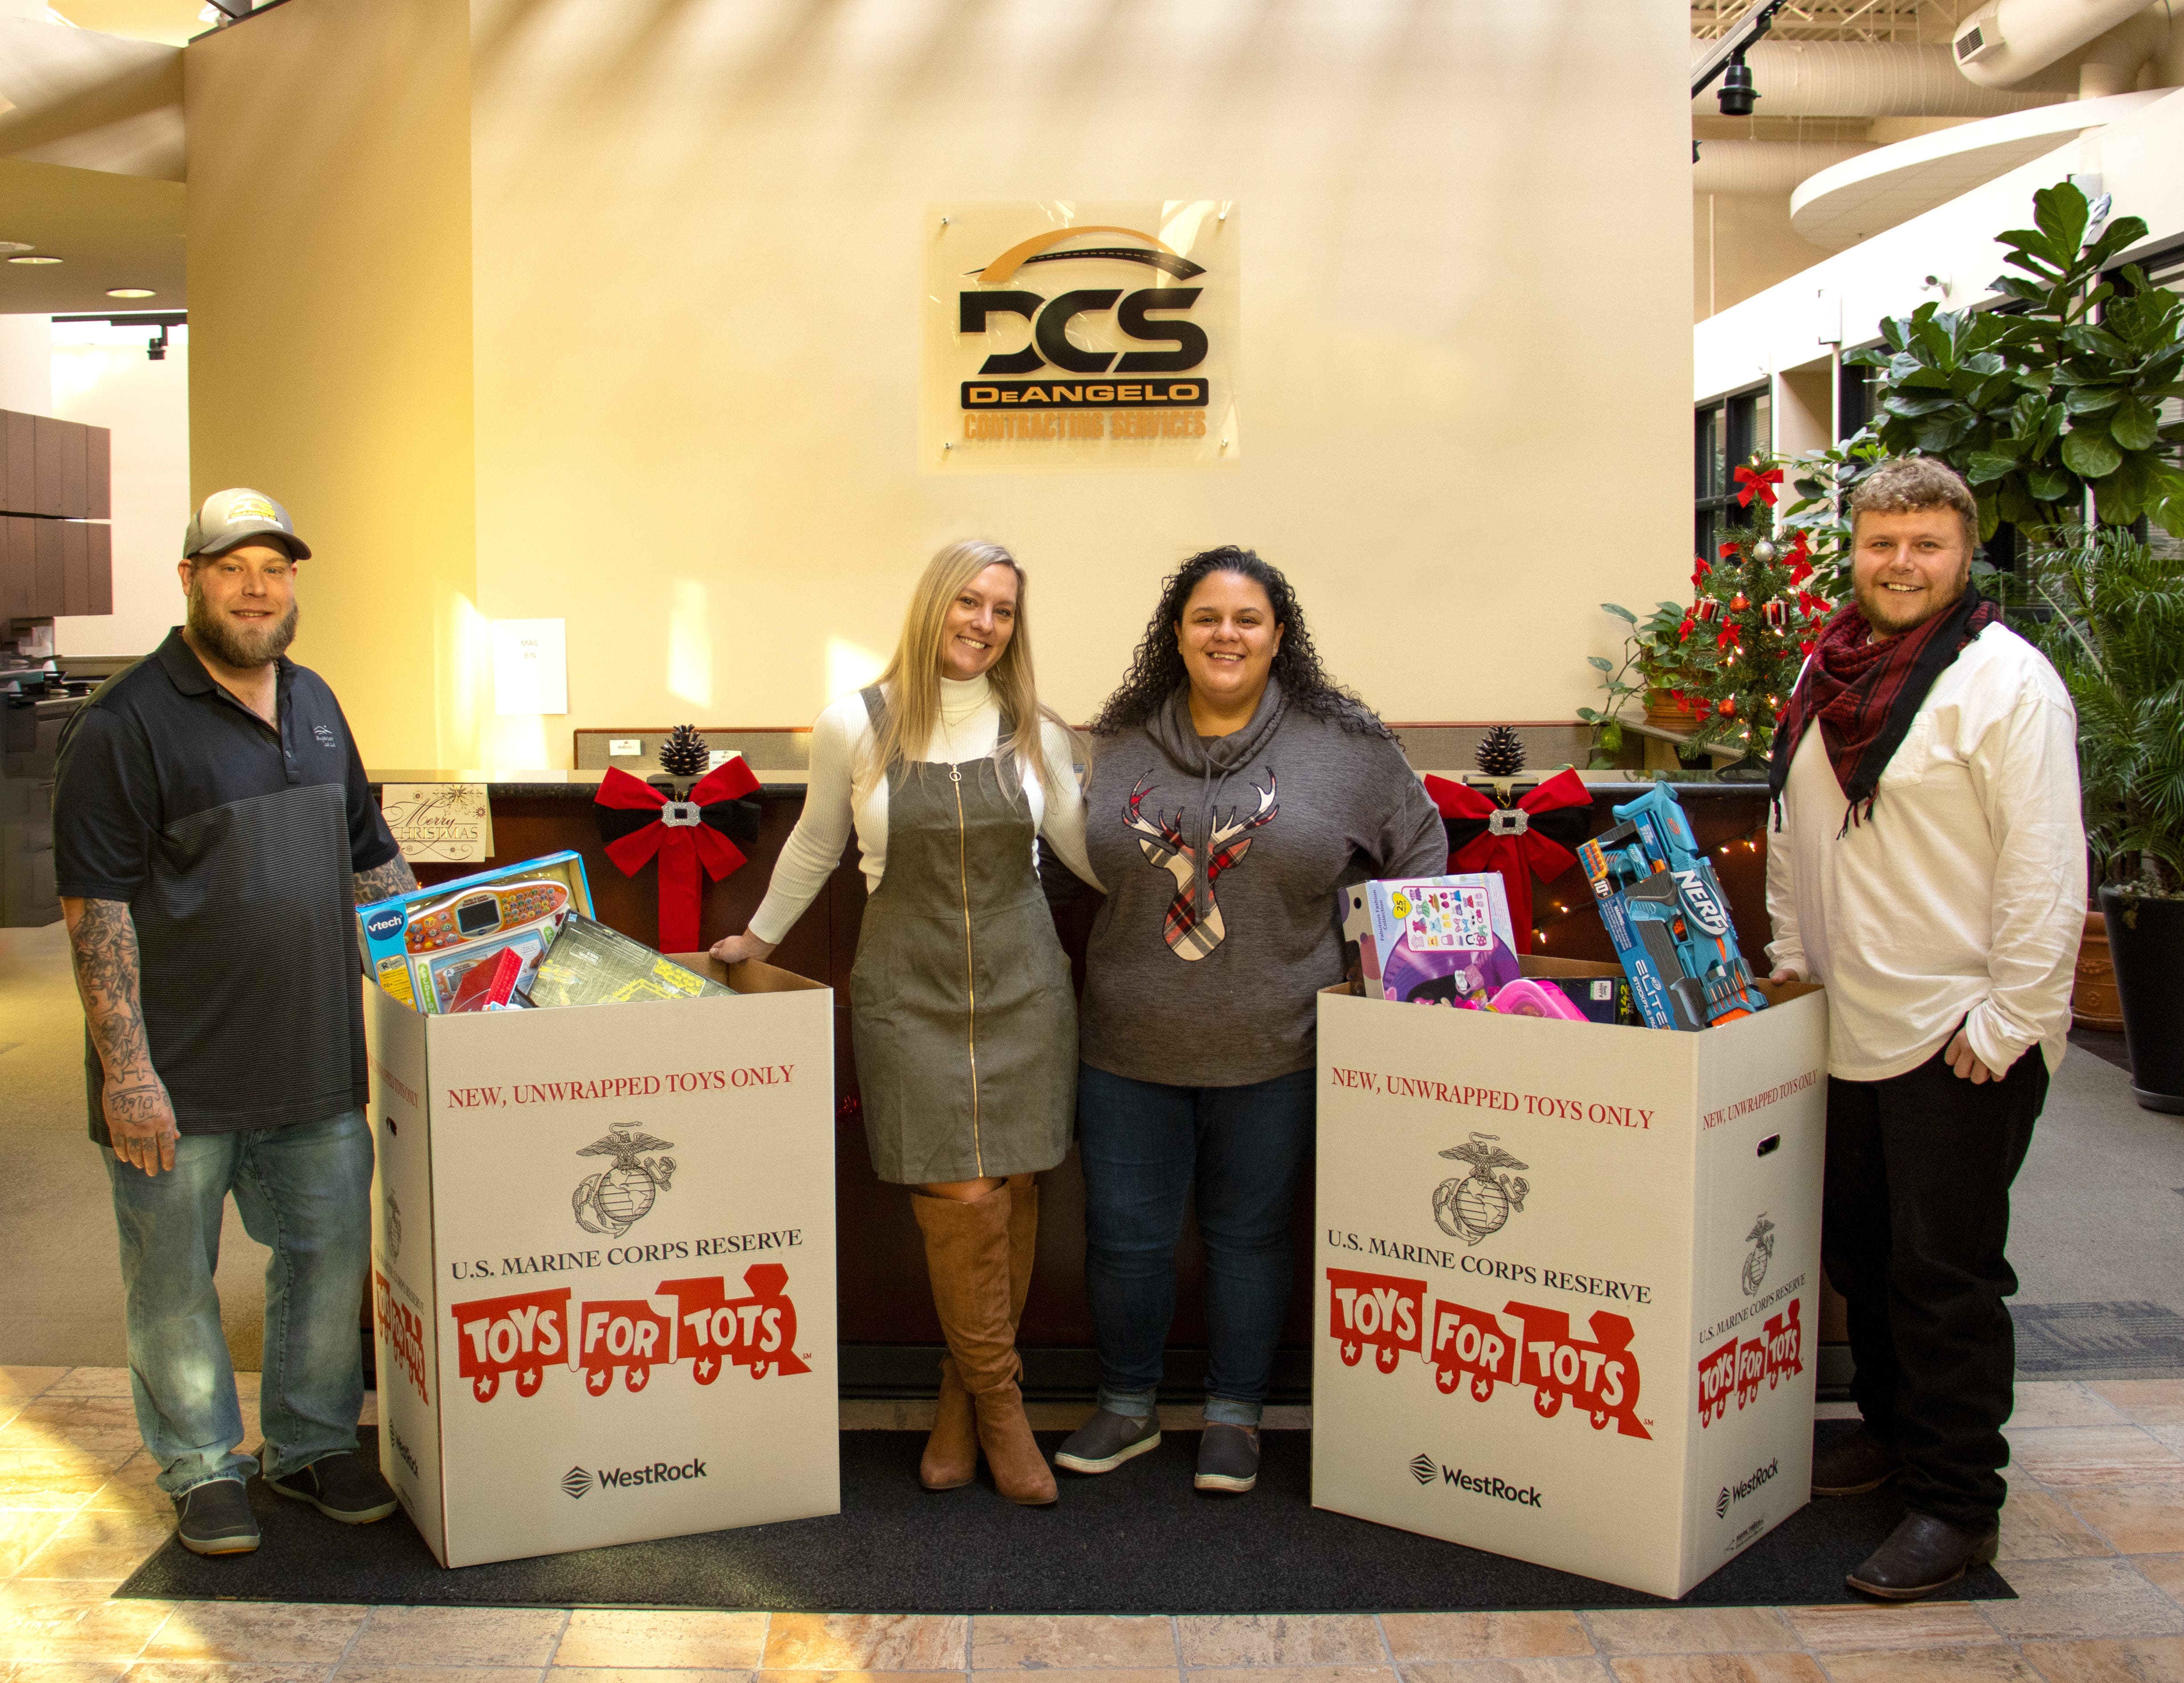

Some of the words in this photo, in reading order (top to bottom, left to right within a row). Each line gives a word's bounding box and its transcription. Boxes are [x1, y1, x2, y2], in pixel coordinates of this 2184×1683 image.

[960, 287, 1208, 374] DCS
[964, 411, 1105, 440] CONTRACTING
[1112, 410, 1207, 438] SERVICES
[391, 827, 478, 839] CHRISTMAS
[396, 796, 456, 829] Merry
[1380, 900, 1388, 930] Collection
[1397, 900, 1403, 911] 25
[1671, 869, 1729, 931] NERF
[368, 916, 403, 932] vtech
[382, 962, 389, 970] R
[1632, 976, 1652, 1016] STOCKPILE
[1635, 959, 1668, 1026] ELITE
[447, 1085, 507, 1108] NEW,
[513, 1076, 661, 1104] UNWRAPPED
[665, 1070, 725, 1092] TOYS
[731, 1064, 795, 1088] ONLY
[1331, 1068, 1382, 1095] NEW,
[1387, 1075, 1519, 1112] UNWRAPPED
[1524, 1095, 1583, 1121] TOYS
[1588, 1103, 1655, 1130] ONLY
[1703, 1108, 1726, 1130] NEW,
[1727, 1088, 1778, 1121] UNWRAPPED
[1779, 1078, 1798, 1099] TOYS
[1798, 1068, 1818, 1090] ONLY
[452, 1260, 495, 1280] U.S.
[502, 1250, 602, 1276] MARINE
[607, 1242, 689, 1266] CORPS
[695, 1229, 803, 1257] RESERVE
[1328, 1229, 1363, 1252] U.S.
[1369, 1238, 1456, 1271] MARINE
[1461, 1256, 1537, 1284] CORPS
[1543, 1269, 1652, 1305] RESERVE
[1699, 1326, 1715, 1344] U.S.
[1716, 1307, 1749, 1336] MARINE
[1750, 1291, 1774, 1316] CORPS
[1775, 1273, 1805, 1303] RESERVE
[463, 1305, 561, 1364] TOYS
[584, 1311, 659, 1358] FOR
[684, 1304, 782, 1352] TOTS
[1336, 1288, 1417, 1341] TOYS
[1436, 1312, 1505, 1373] FOR
[1529, 1340, 1625, 1406] TOTS
[1702, 1353, 1733, 1400] TOYS
[1739, 1349, 1762, 1381] FOR
[1769, 1328, 1797, 1363] TOTS
[1644, 1418, 1654, 1426] SM
[597, 1459, 707, 1490] WestRock
[1442, 1464, 1542, 1508] WestRock
[1733, 1457, 1778, 1504] WestRock
